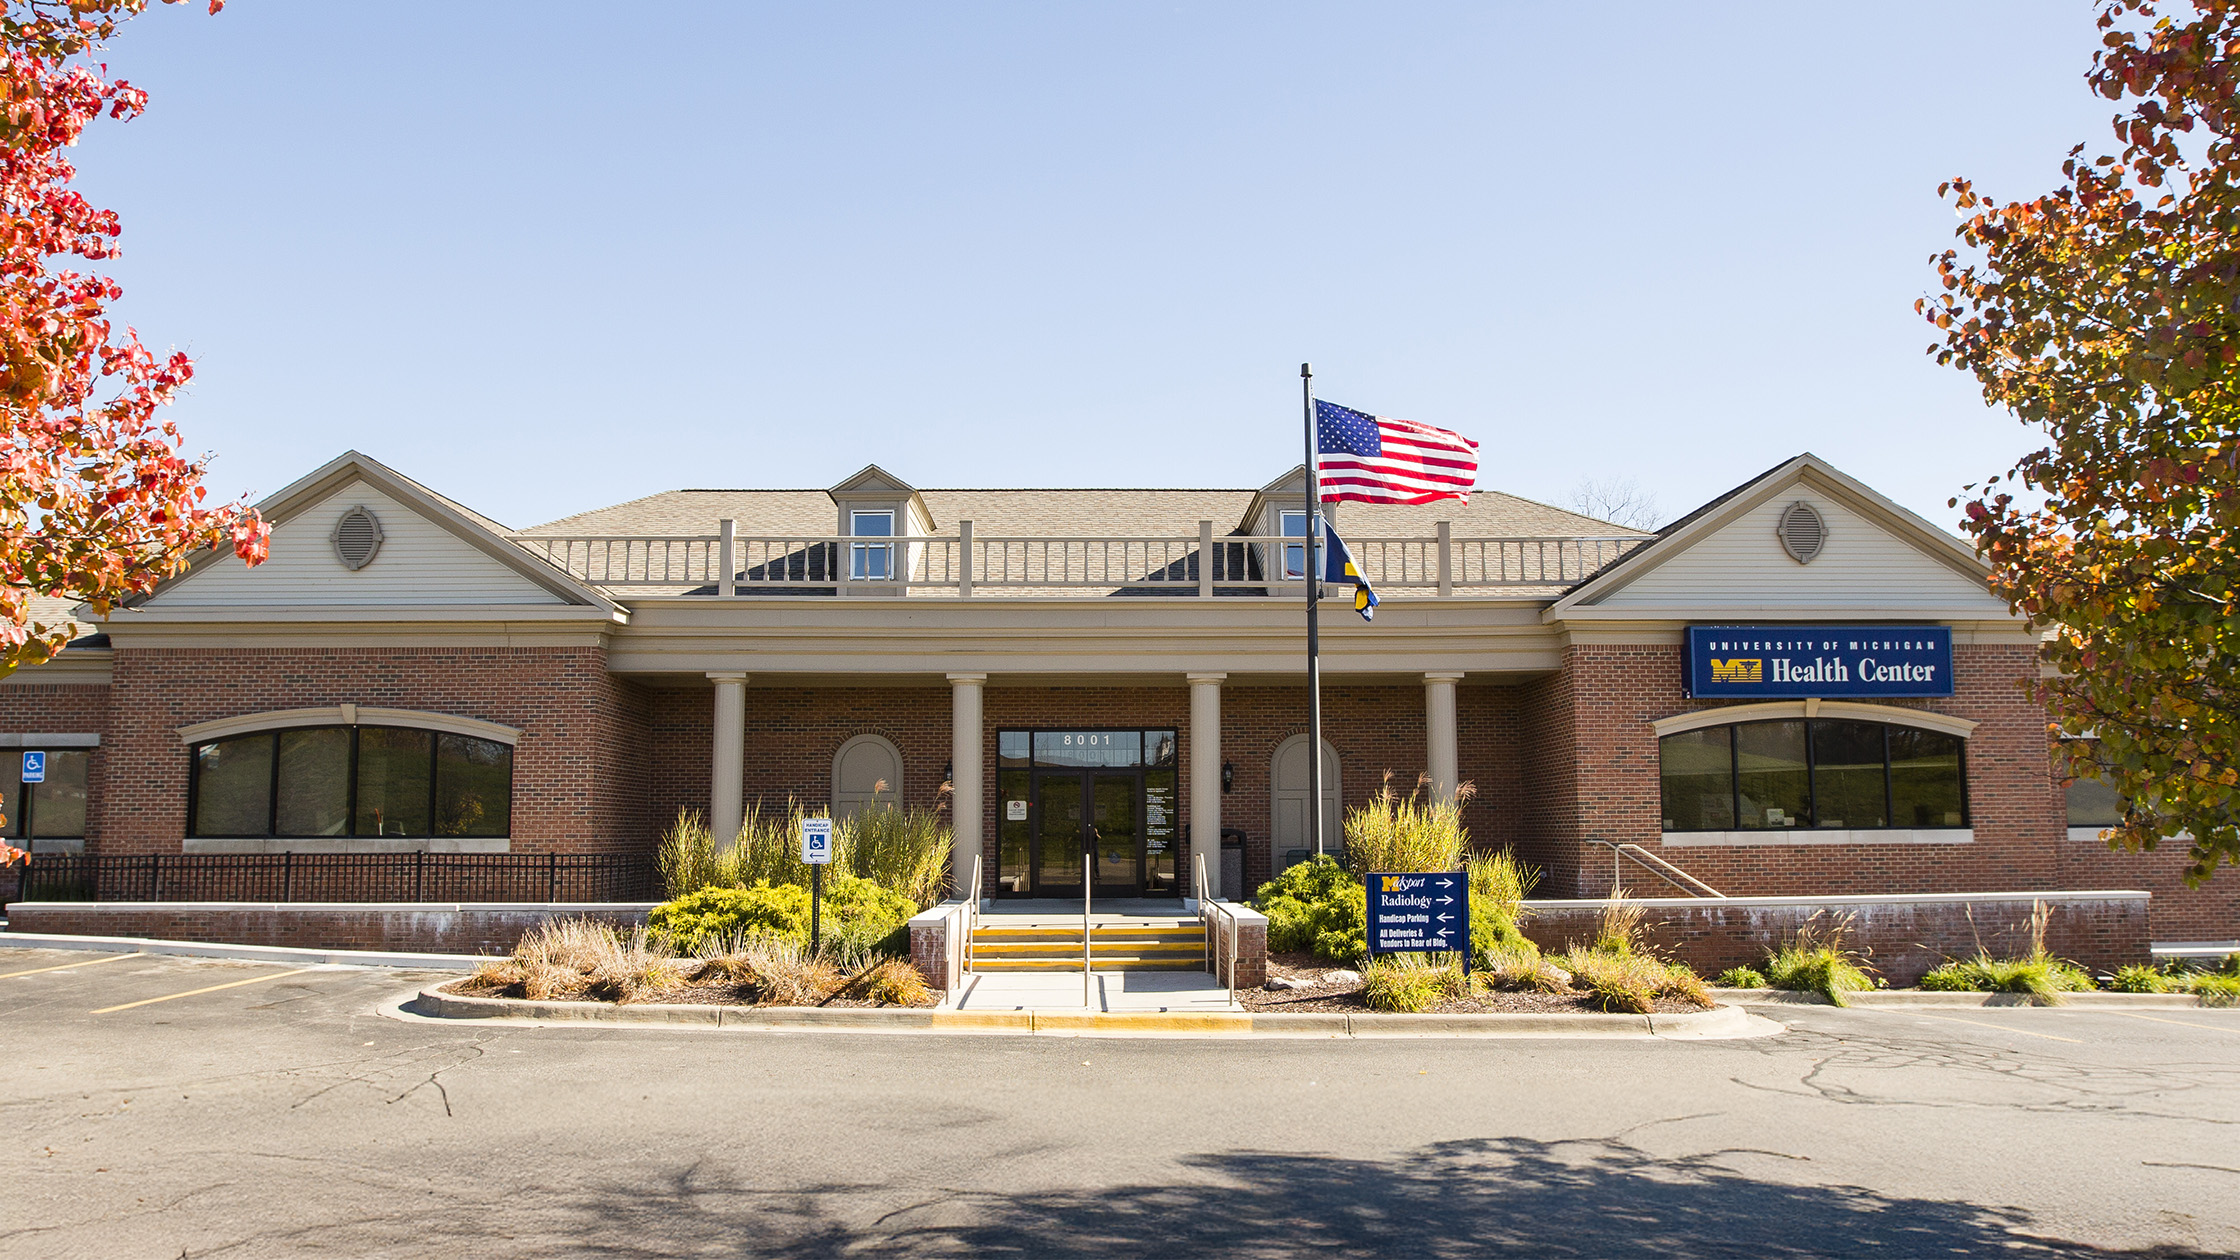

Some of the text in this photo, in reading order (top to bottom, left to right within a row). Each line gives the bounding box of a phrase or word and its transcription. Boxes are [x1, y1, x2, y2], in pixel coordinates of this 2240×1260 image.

[1709, 641, 1936, 650] UNIVERSITY OF MICHIGAN
[1771, 657, 1849, 682] Health
[1858, 657, 1936, 682] Center
[1064, 735, 1110, 745] 8001
[1381, 894, 1432, 908] Radiology
[1379, 914, 1429, 923] Handicap Parking
[1380, 929, 1388, 938] All
[1389, 929, 1417, 938] Deliveries
[1380, 938, 1447, 948] Vendors to Rear of Bldg.
